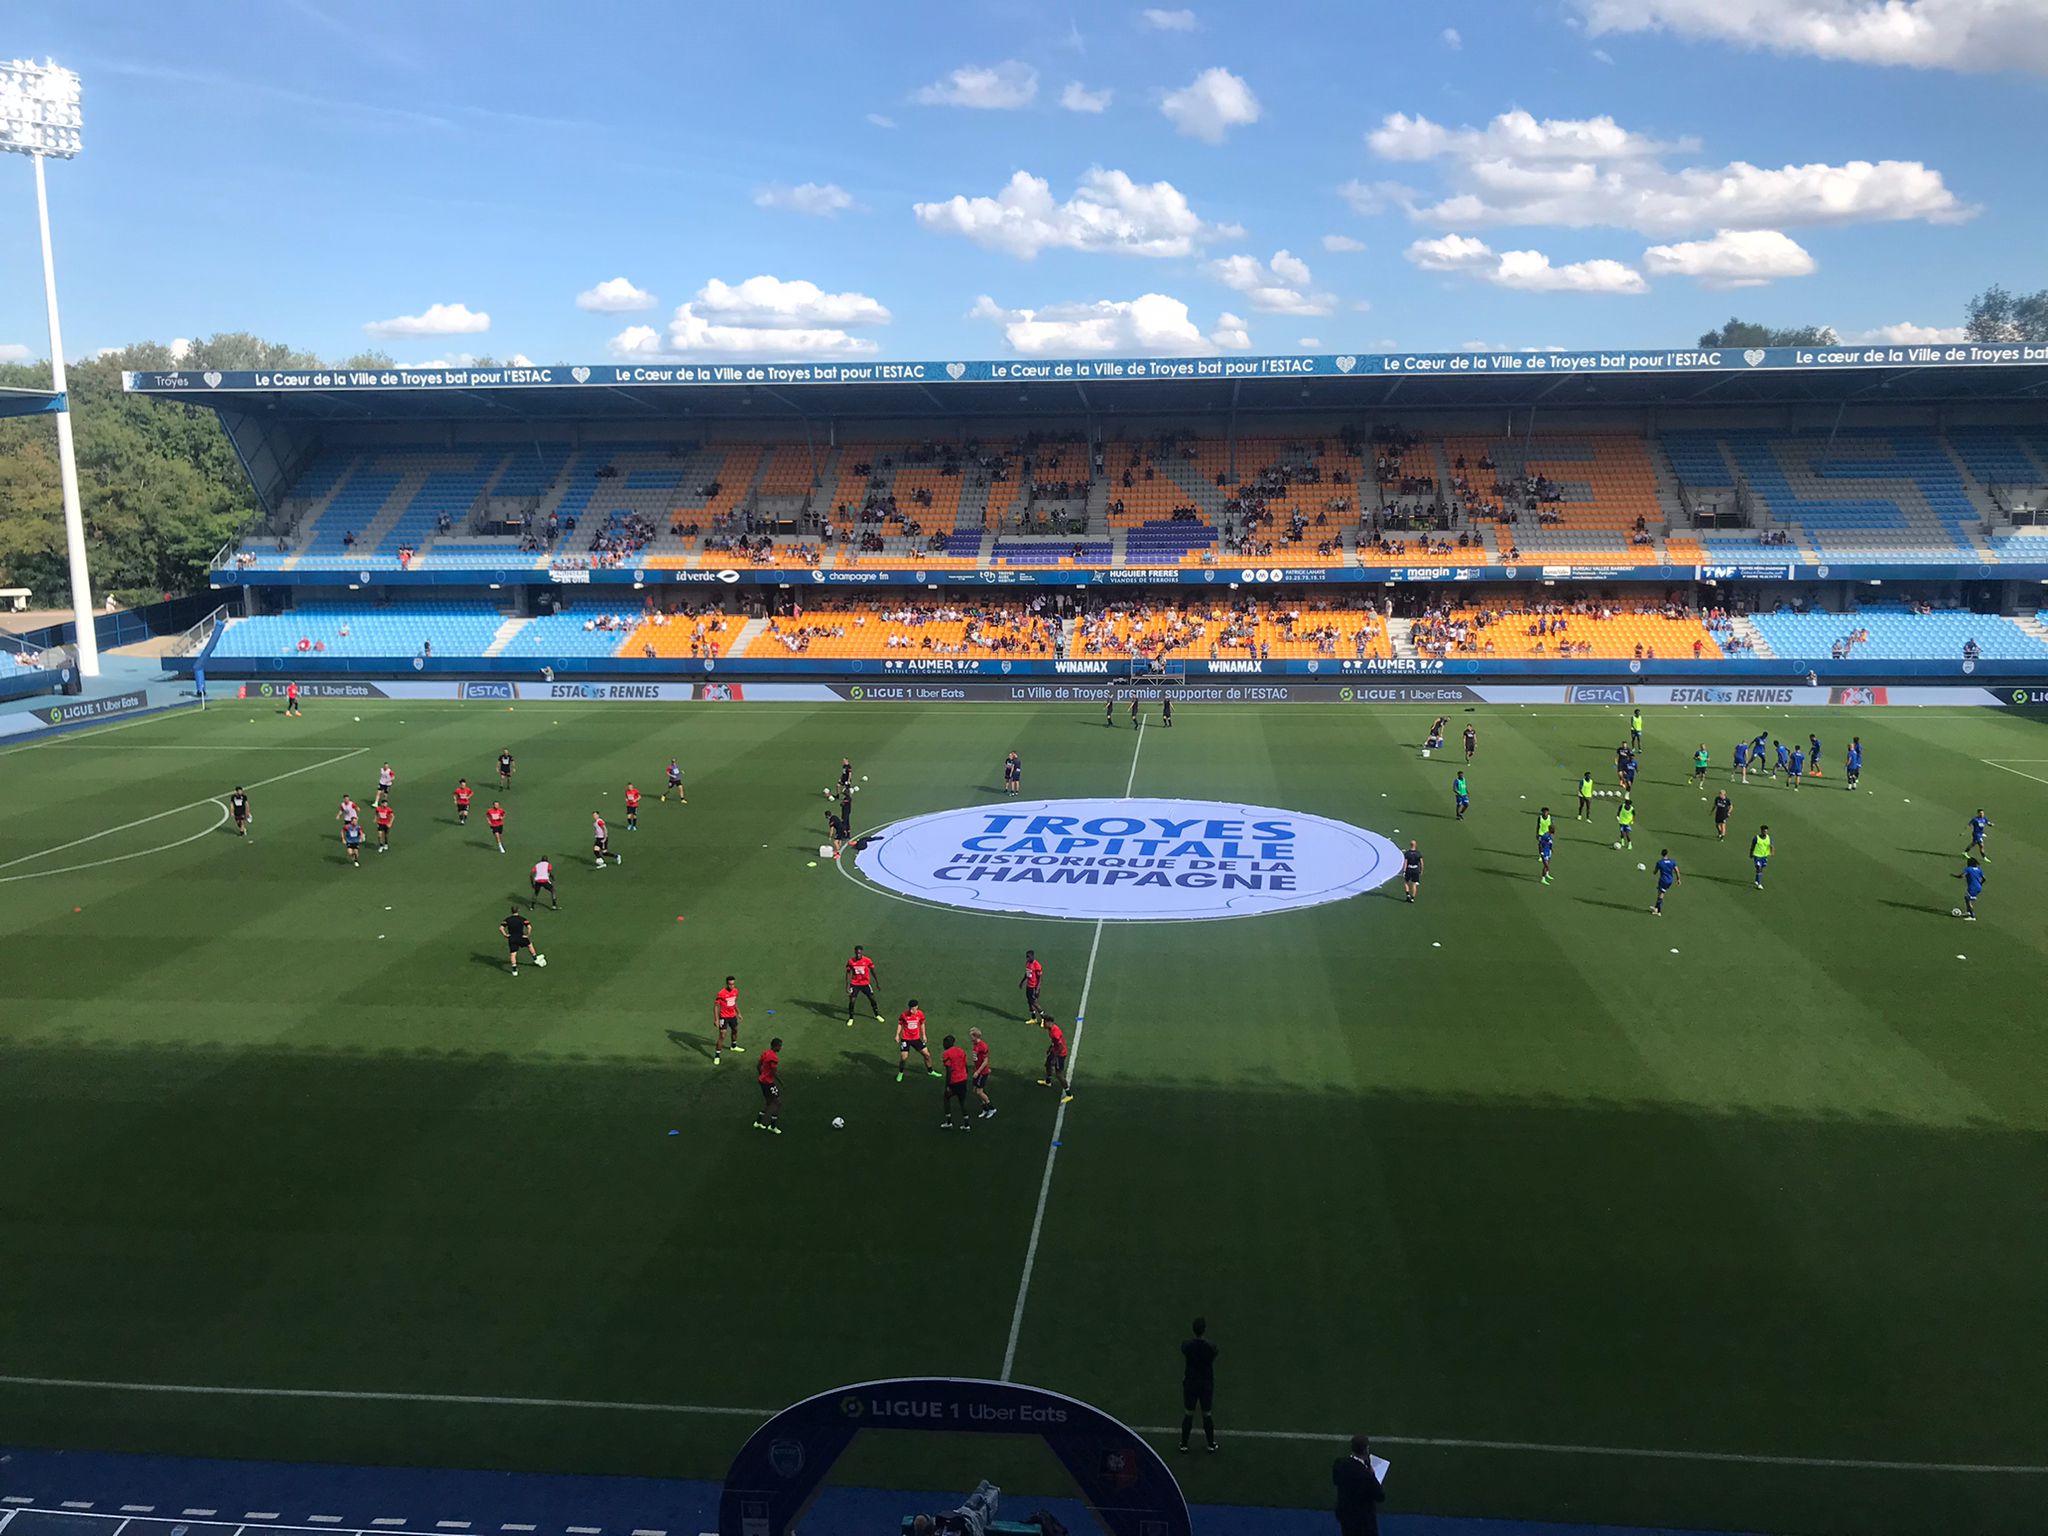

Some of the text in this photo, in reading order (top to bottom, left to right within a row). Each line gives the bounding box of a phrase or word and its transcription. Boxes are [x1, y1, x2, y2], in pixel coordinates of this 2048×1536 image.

[1796, 350, 1813, 364] Le
[1864, 349, 1884, 363] de
[1888, 349, 1903, 362] la
[1908, 348, 1940, 362] Ville
[1945, 348, 1965, 361] de
[1970, 347, 2019, 363] Troyes
[992, 364, 1006, 377] Le
[1054, 363, 1073, 376] de
[1077, 363, 1091, 376] la
[1092, 362, 1123, 375] Ville
[1127, 362, 1146, 375] de
[1150, 361, 1194, 377] Troyes
[1198, 361, 1222, 374] bat
[1225, 362, 1258, 376] pour
[1384, 357, 1400, 370] Le
[1450, 356, 1469, 369] de
[1473, 356, 1487, 369] la
[1491, 355, 1522, 368] Ville
[1526, 355, 1546, 368] de
[1550, 355, 1597, 371] Troyes
[1601, 354, 1626, 367] bat
[1629, 356, 1662, 370] pour
[255, 373, 269, 386] Le
[314, 372, 330, 385] de
[334, 372, 346, 385] la
[350, 372, 377, 385] Ville
[381, 371, 398, 384] de
[401, 371, 442, 387] Troyes
[446, 370, 468, 384] bat
[471, 372, 501, 386] pour
[615, 368, 631, 381] Le
[676, 368, 694, 380] de
[697, 368, 710, 380] la
[714, 367, 743, 380] Ville
[746, 367, 764, 379] de
[767, 366, 810, 382] Troyes
[815, 366, 837, 379] bat
[840, 368, 872, 382] pour
[154, 375, 189, 389] Troyes
[829, 572, 889, 583] champagne fm
[1408, 567, 1450, 578] mangin
[908, 660, 954, 670] AUMER
[1055, 661, 1108, 673] WINAMAX
[1208, 660, 1262, 673] WINAMAX
[1367, 659, 1416, 670] AUMER
[322, 686, 344, 695] Uber
[345, 686, 368, 696] Eats
[551, 686, 588, 698] ESTAC
[609, 686, 660, 698] RENNES
[867, 688, 904, 698] LIGUE
[916, 688, 940, 698] Uber
[941, 688, 965, 698] Eats
[1012, 687, 1024, 698] La
[1028, 687, 1052, 698] Ville
[1056, 687, 1069, 698] de
[1117, 687, 1161, 700] premier
[1165, 688, 1223, 700] supporter
[1226, 688, 1241, 699] de
[1357, 689, 1396, 699] LIGUE
[1410, 689, 1436, 699] Uber
[1437, 689, 1462, 699] Eats
[1670, 689, 1712, 702] ESTAC
[1736, 689, 1793, 702] RENNES
[63, 703, 94, 719] LIGUE
[103, 700, 121, 712] Uber
[121, 697, 139, 708] Eats
[983, 814, 1296, 841] TROYES
[961, 835, 1295, 860] CAPITALE
[949, 853, 1294, 873] HISTORIQUE DE LA
[932, 865, 1297, 891] CHAMPAGNE
[872, 1399, 1068, 1423] LIGUE 1 Uber Eats
